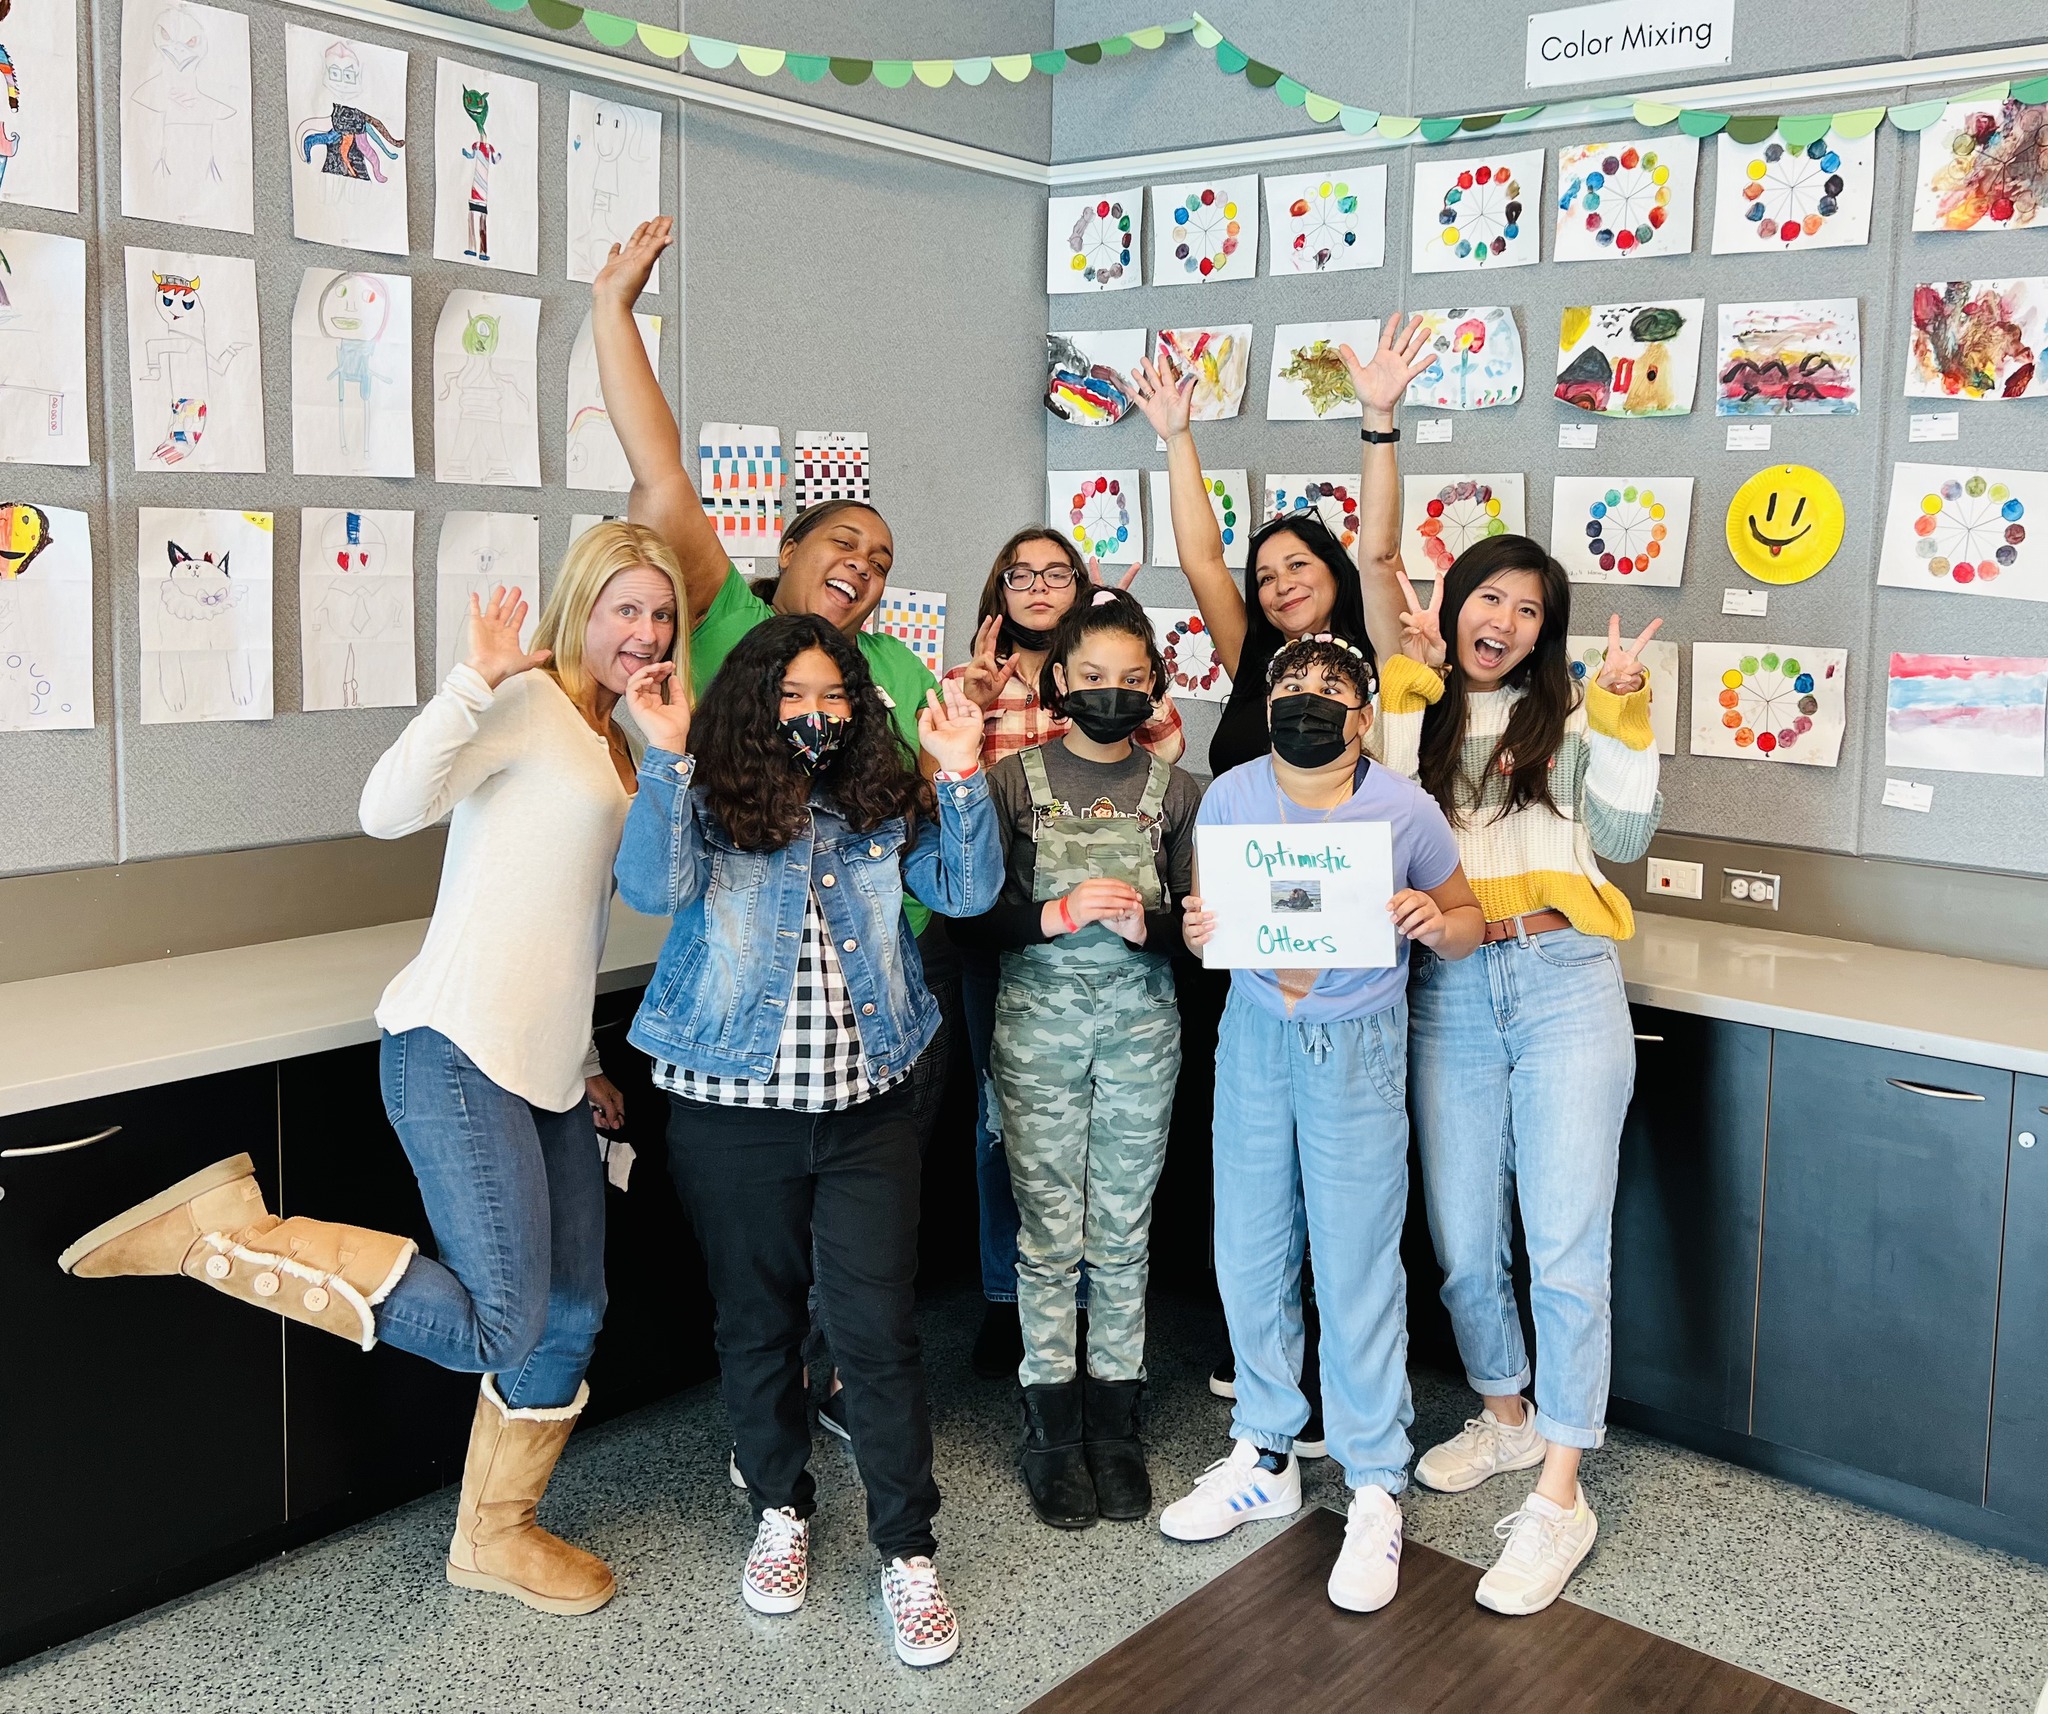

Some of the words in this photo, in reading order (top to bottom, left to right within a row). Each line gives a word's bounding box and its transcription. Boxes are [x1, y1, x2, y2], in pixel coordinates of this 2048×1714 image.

[1541, 29, 1614, 61] Color
[1620, 21, 1713, 50] Mixing
[1245, 839, 1352, 878] Optimistic
[1256, 924, 1338, 955] Otters
